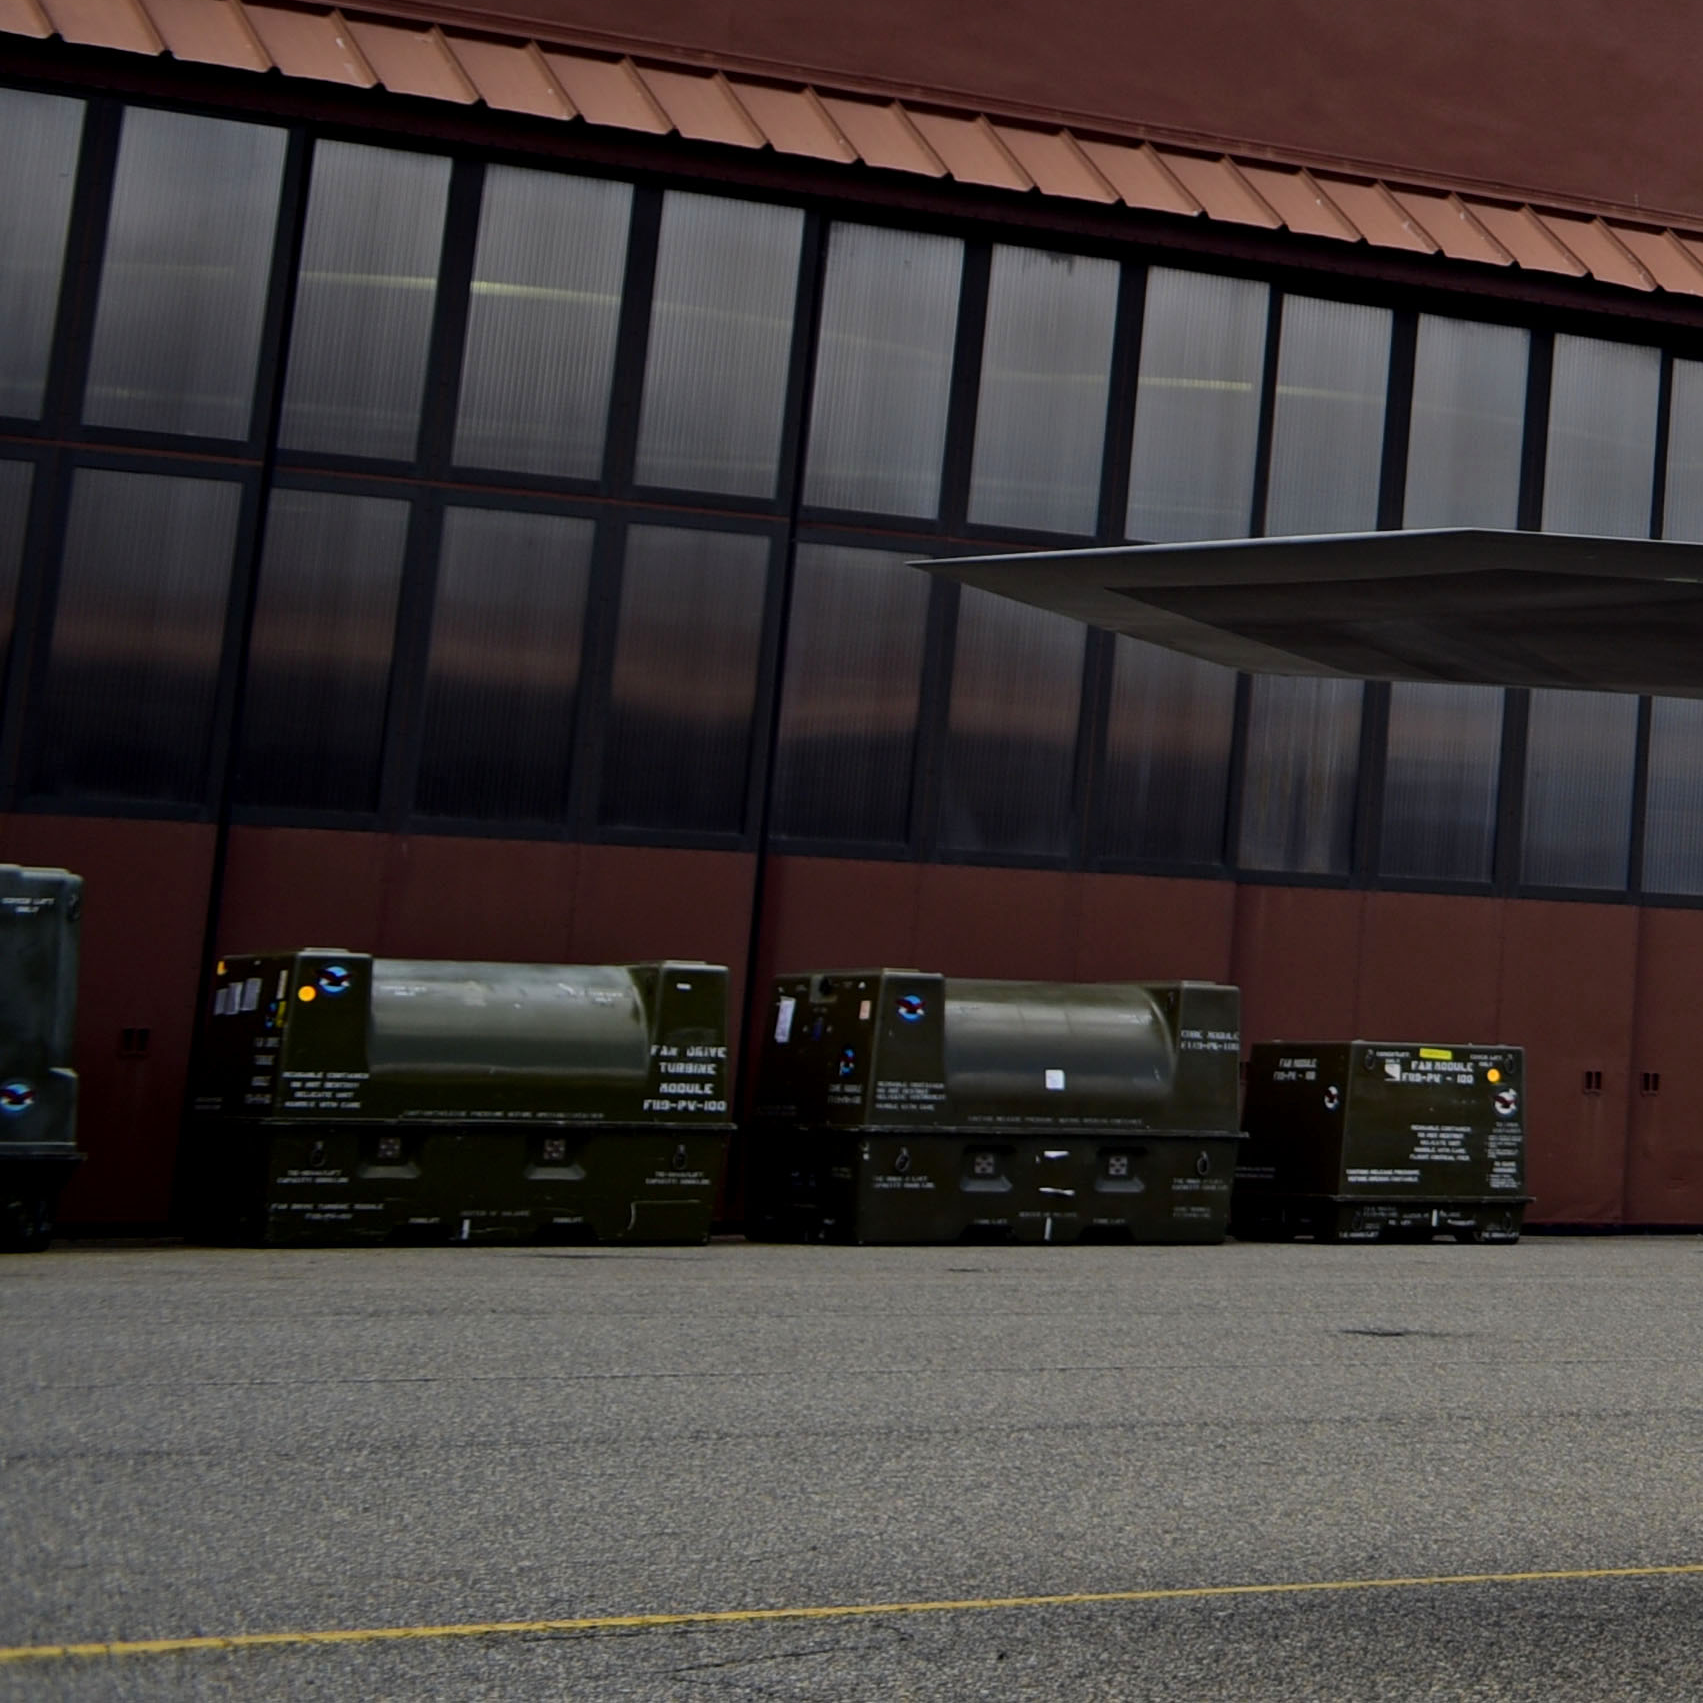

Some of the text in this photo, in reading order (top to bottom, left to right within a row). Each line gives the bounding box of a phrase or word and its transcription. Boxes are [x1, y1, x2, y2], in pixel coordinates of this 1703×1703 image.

[650, 1045, 727, 1058] FAN DRIVE
[659, 1062, 717, 1075] TURBINE
[1434, 1061, 1474, 1072] MODULE
[659, 1082, 714, 1094] MODULE
